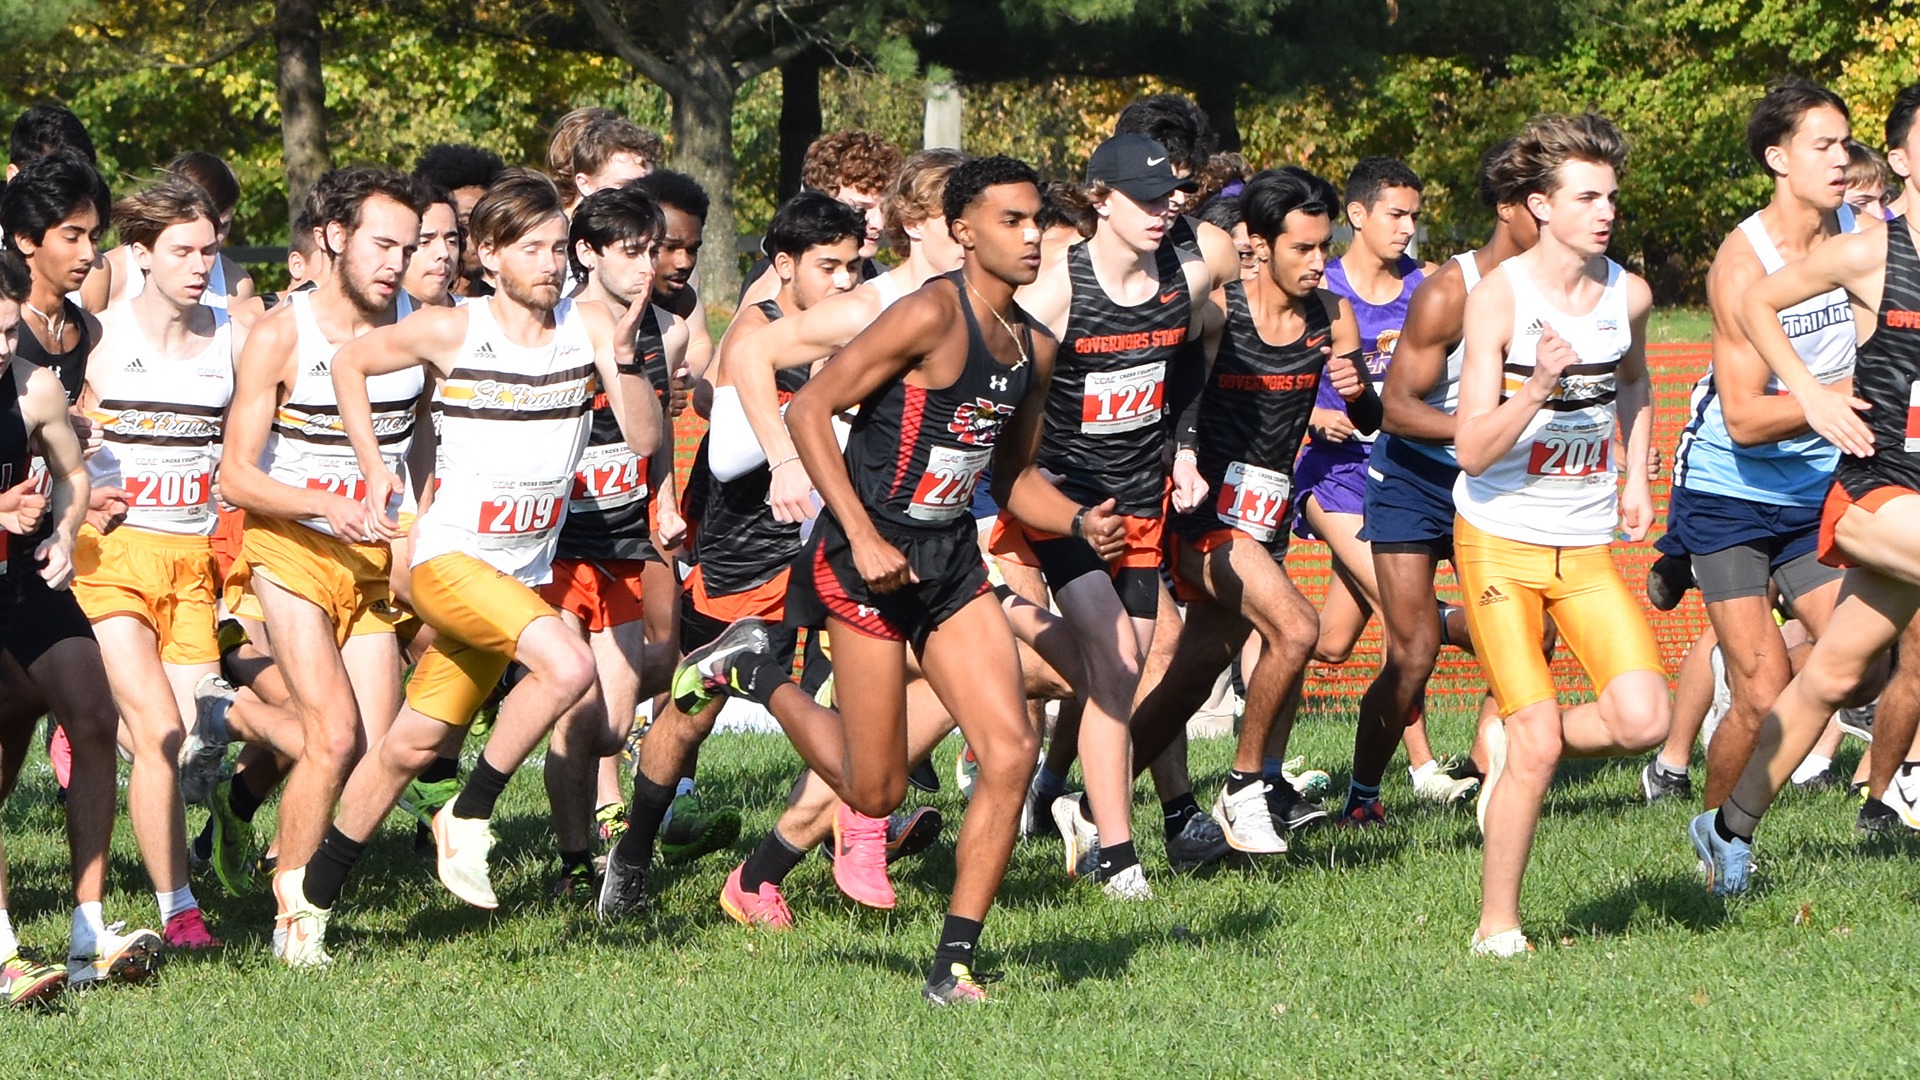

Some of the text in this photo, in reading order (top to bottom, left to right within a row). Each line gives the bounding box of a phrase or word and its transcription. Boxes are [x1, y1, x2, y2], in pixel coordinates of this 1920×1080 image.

[1782, 301, 1854, 338] TRINIT
[1075, 333, 1149, 353] GOVERNORS
[1096, 379, 1156, 421] 122
[1540, 436, 1602, 475] 204
[135, 468, 201, 507] 206
[319, 473, 359, 500] 21
[582, 455, 640, 497] 124
[489, 493, 555, 533] 209
[1227, 480, 1283, 527] 132
[1479, 595, 1510, 606] adidas
